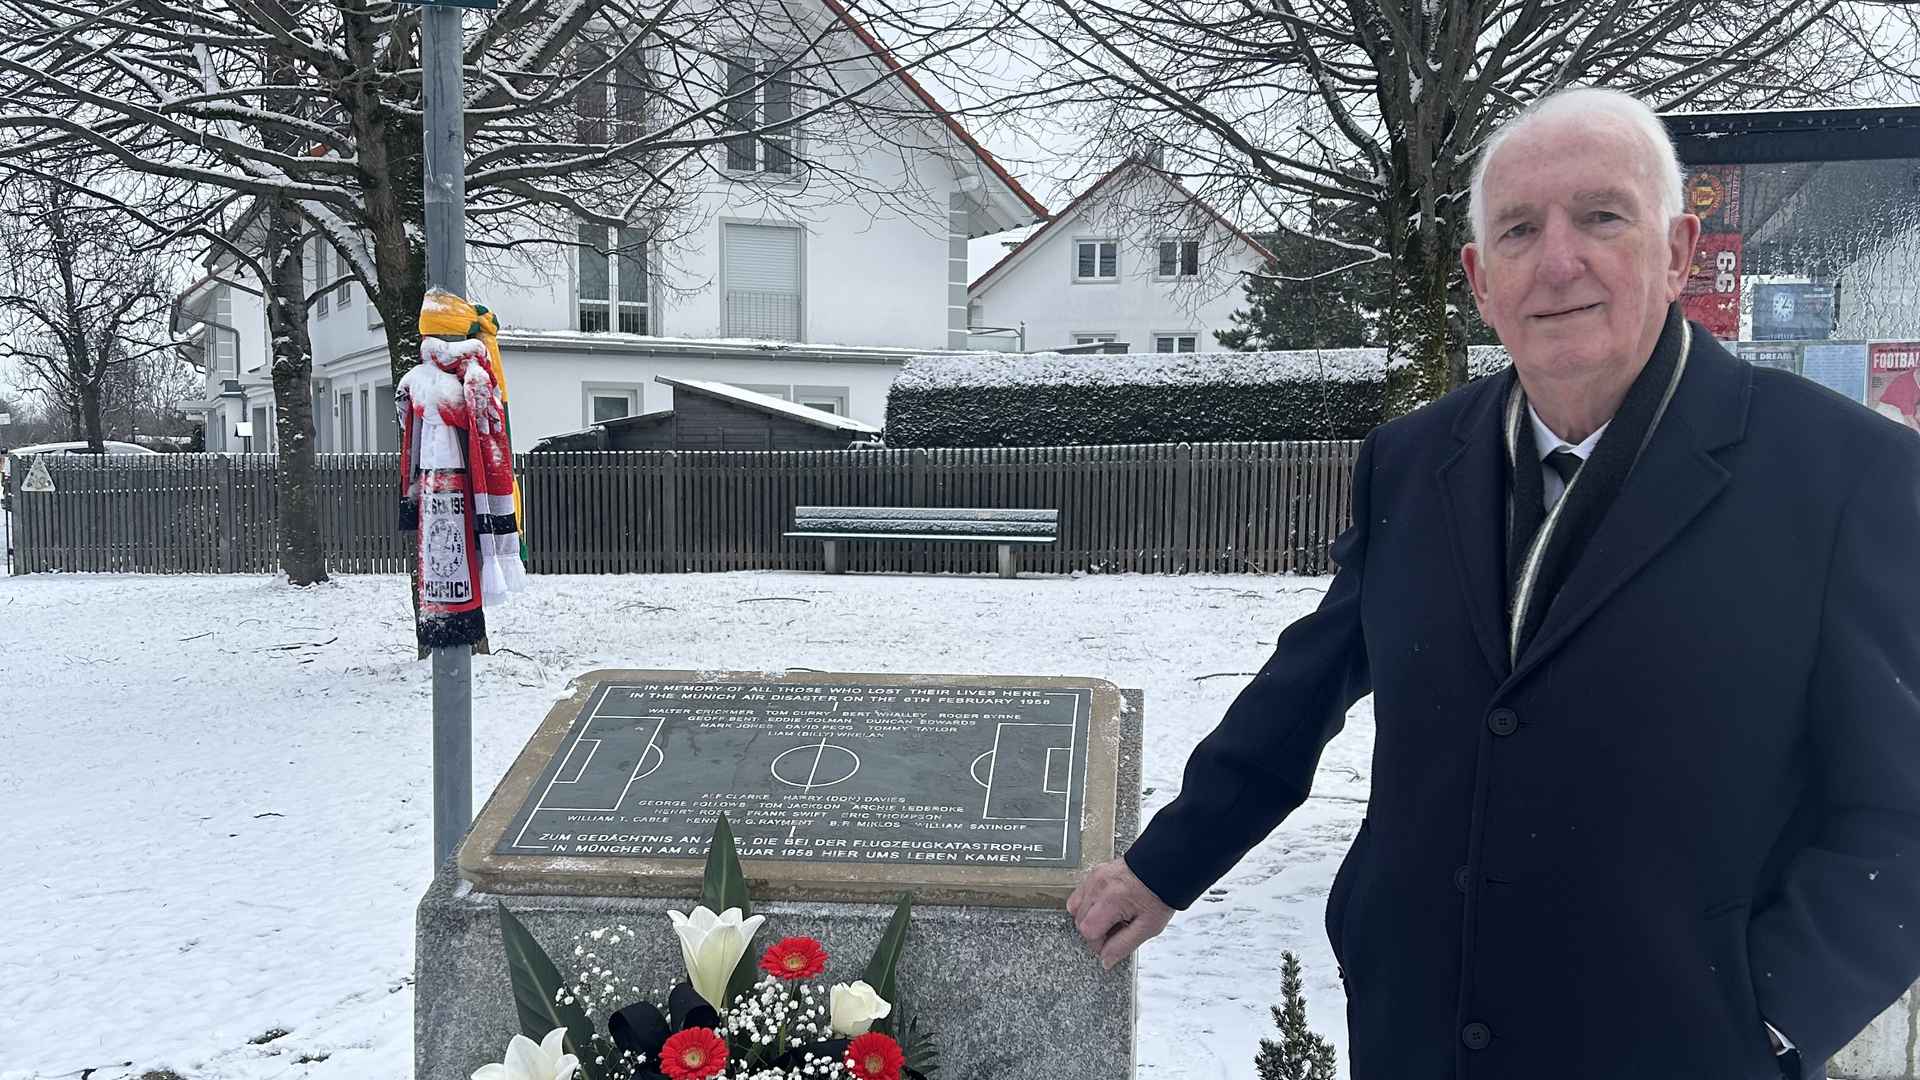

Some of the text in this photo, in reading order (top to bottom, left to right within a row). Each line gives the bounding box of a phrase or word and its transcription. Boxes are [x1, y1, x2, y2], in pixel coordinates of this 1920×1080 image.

[1741, 352, 1793, 361] THE DREAM
[911, 688, 950, 696] THEIR
[771, 694, 839, 702] DISASTER
[938, 697, 1014, 705] FEBRUARY
[576, 833, 673, 844] GEDÄCHTNIS
[752, 837, 779, 845] DIE
[815, 839, 847, 847] DER
[853, 840, 1044, 852] FLUGZEUGKATASTROPHE
[575, 844, 653, 853] MÜNCHEN
[657, 846, 682, 854] AM
[702, 847, 774, 856] FRUAR
[781, 849, 814, 857] 1958
[821, 850, 859, 858] HIER
[866, 851, 900, 859] UMS
[907, 852, 958, 860] LEBEN
[965, 853, 1021, 862] KAMEN
